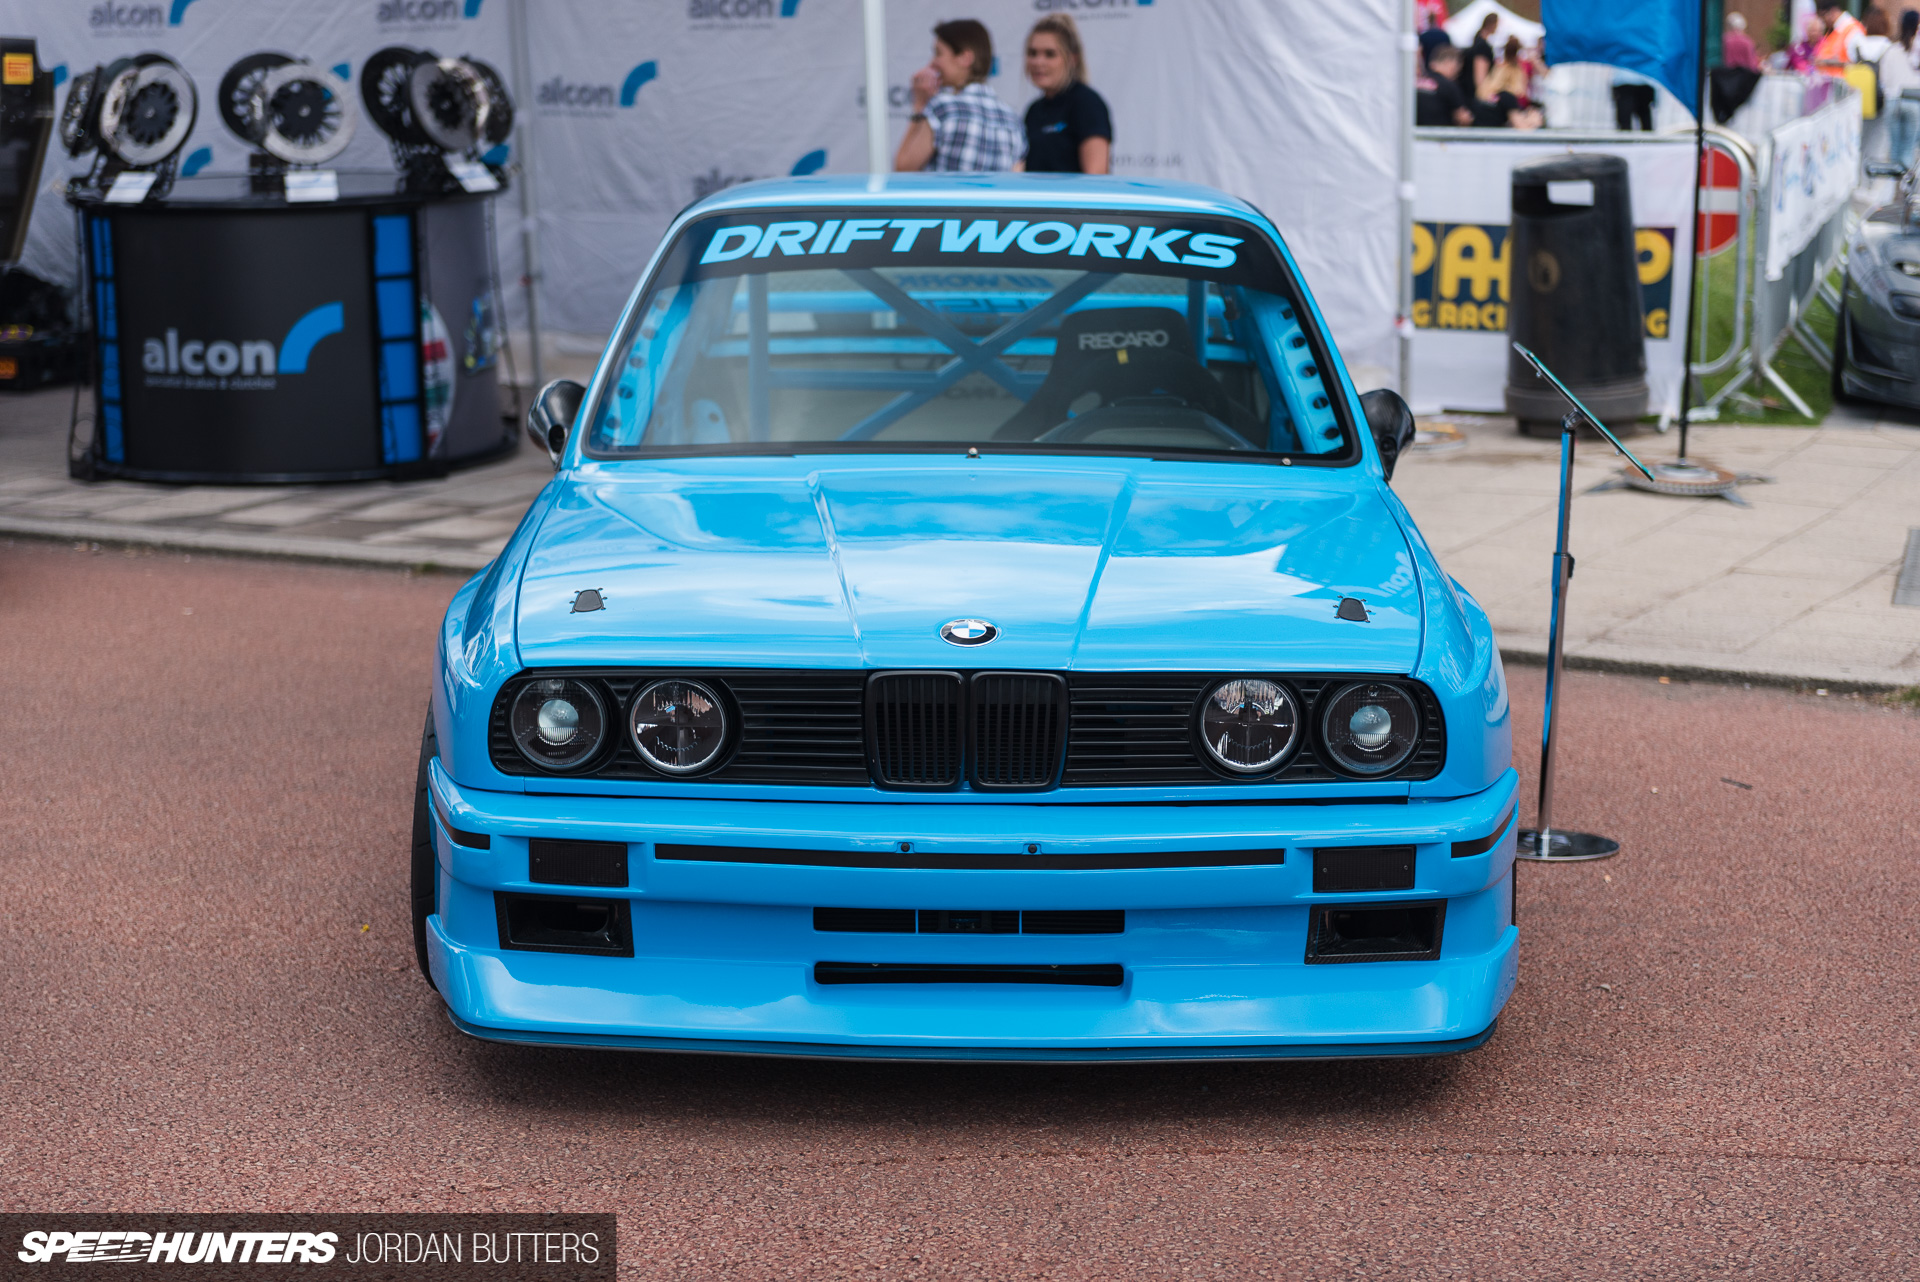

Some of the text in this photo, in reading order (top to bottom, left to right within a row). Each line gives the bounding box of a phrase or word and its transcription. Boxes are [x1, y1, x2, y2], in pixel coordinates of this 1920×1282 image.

[89, 0, 164, 27] alcon
[538, 76, 614, 106] alcon
[700, 218, 1244, 269] DRIFTWORKS
[142, 327, 276, 376] alcon
[1077, 329, 1170, 350] RECARO
